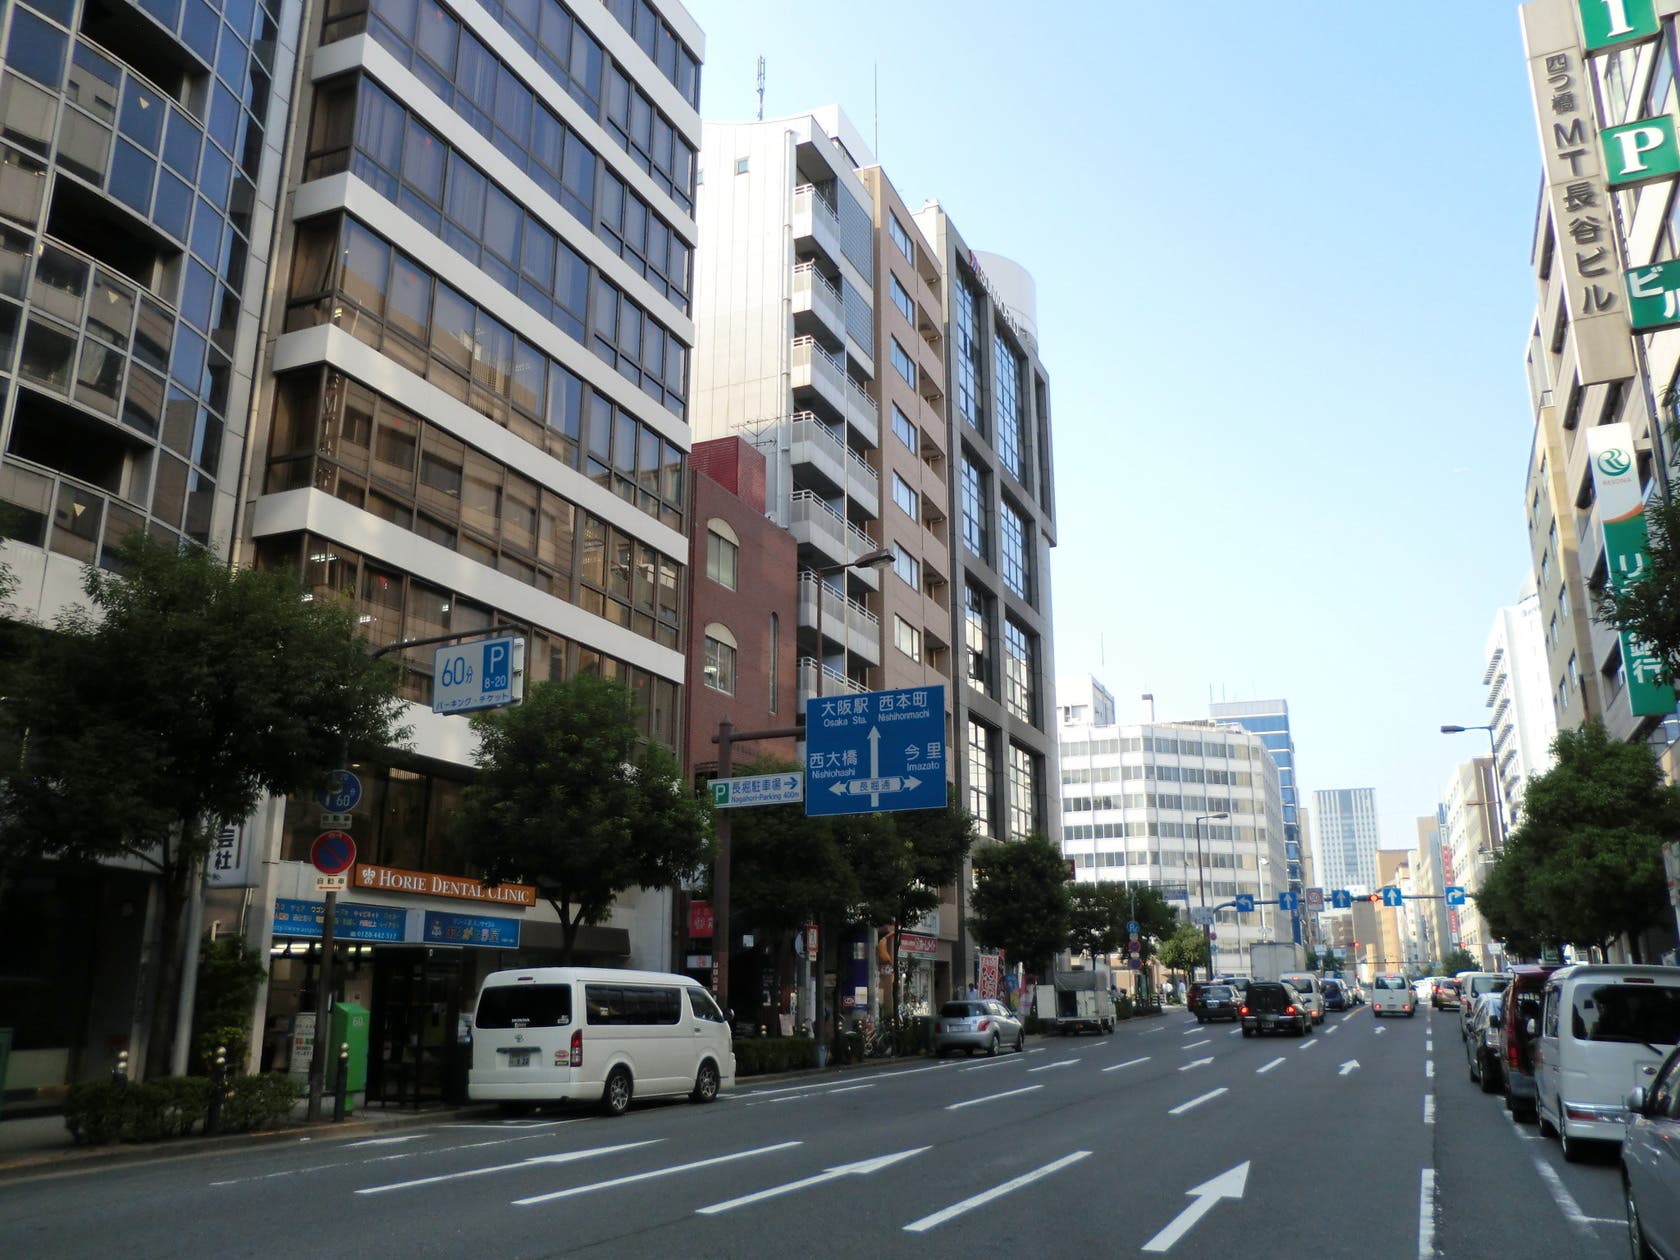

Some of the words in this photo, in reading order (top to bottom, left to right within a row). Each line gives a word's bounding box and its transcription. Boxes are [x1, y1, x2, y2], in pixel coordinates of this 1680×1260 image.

[1613, 126, 1665, 176] P
[490, 646, 505, 673] P
[442, 656, 474, 687] 60分
[484, 674, 506, 689] 8-20
[821, 697, 869, 717] 大阪駅
[879, 691, 928, 711] 西本町
[823, 718, 848, 727] Osaka
[852, 715, 867, 725] Sta.
[878, 708, 930, 722] Nishihonmachi
[810, 749, 858, 769] 西大橋
[904, 742, 942, 761] 今里
[812, 767, 856, 779] Nishiohashi
[906, 760, 940, 772] Imazato
[715, 784, 726, 801] P
[732, 777, 782, 794] 長堀駐車場
[860, 779, 891, 792] 長堀通
[379, 869, 427, 891] HORIE
[432, 876, 485, 898] DENTAL
[487, 885, 530, 902] CLINIC
